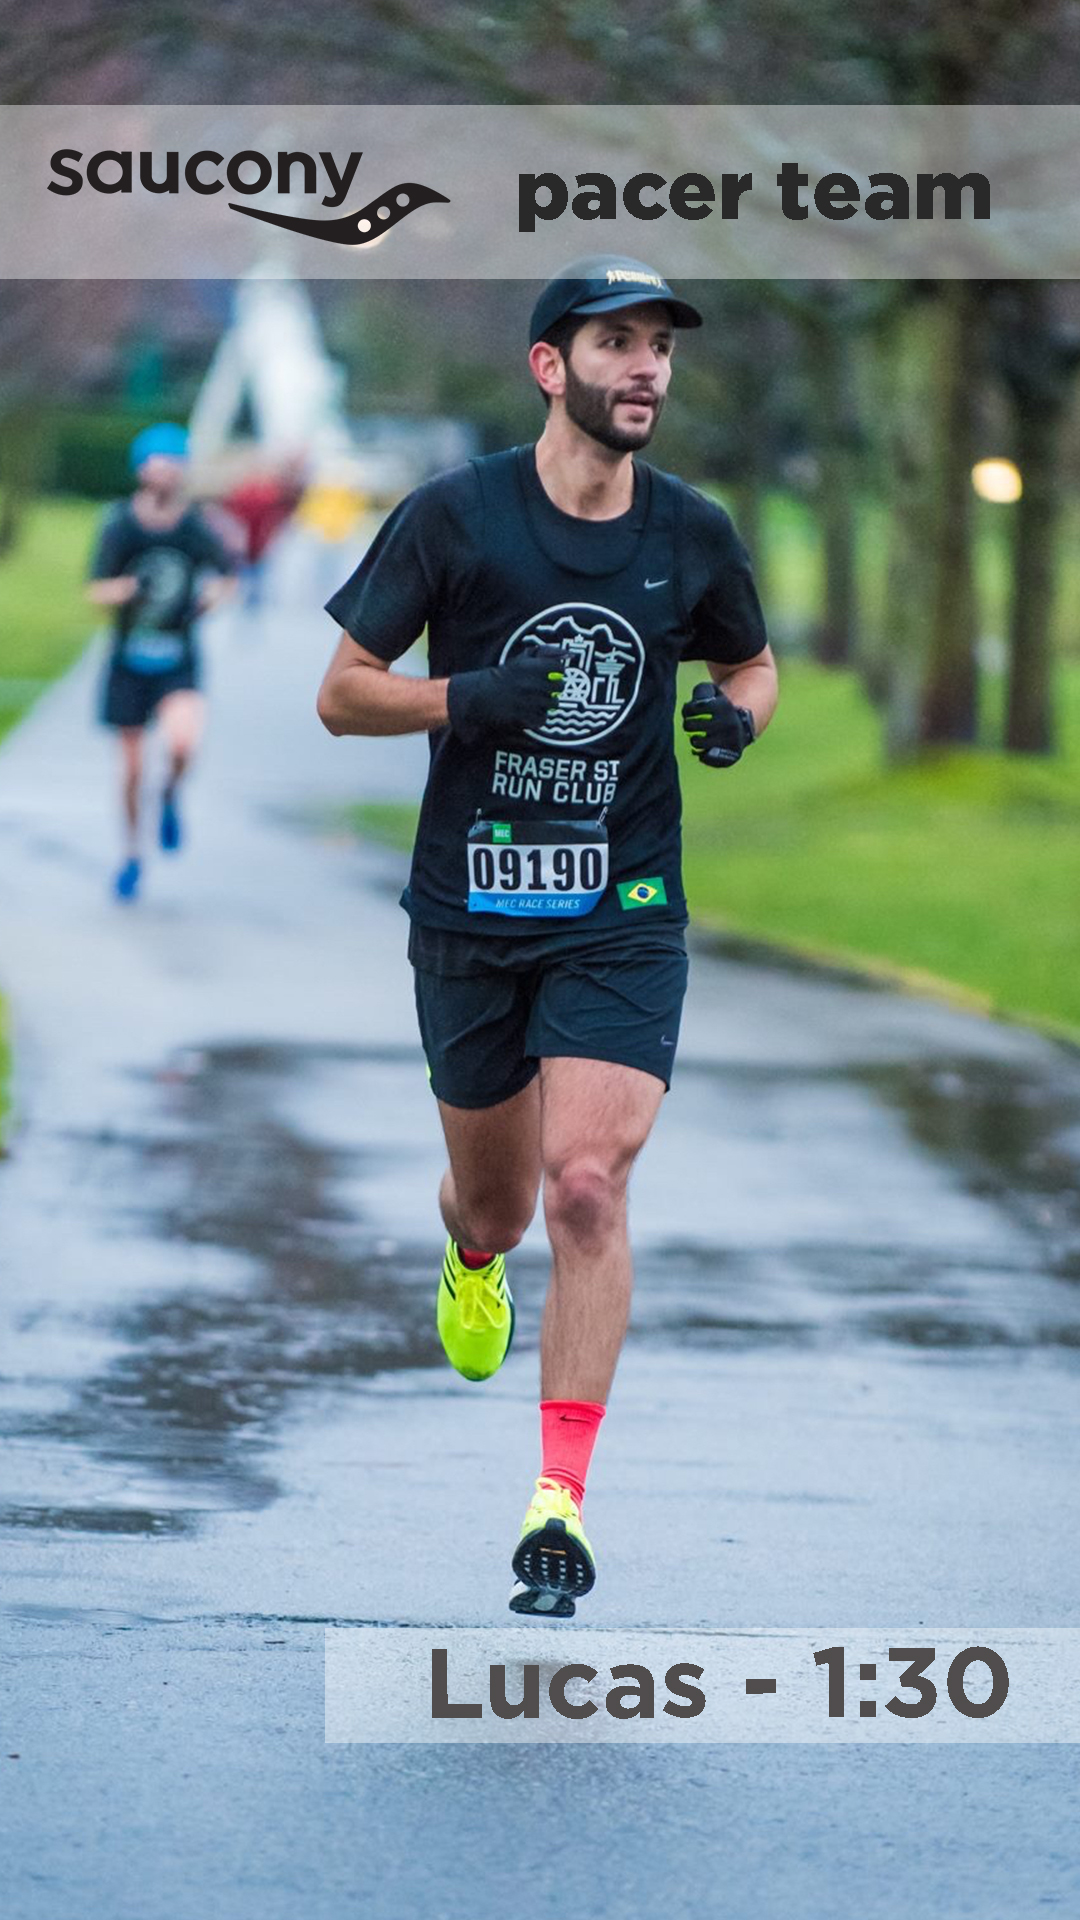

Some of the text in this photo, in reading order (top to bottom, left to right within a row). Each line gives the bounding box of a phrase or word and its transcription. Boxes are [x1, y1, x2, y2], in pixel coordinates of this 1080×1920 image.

[494, 750, 620, 781] FRASER ST
[492, 772, 616, 804] RUN CLUB
[473, 847, 602, 891] 09190
[519, 898, 543, 909] RACE
[545, 898, 581, 909] SERIES
